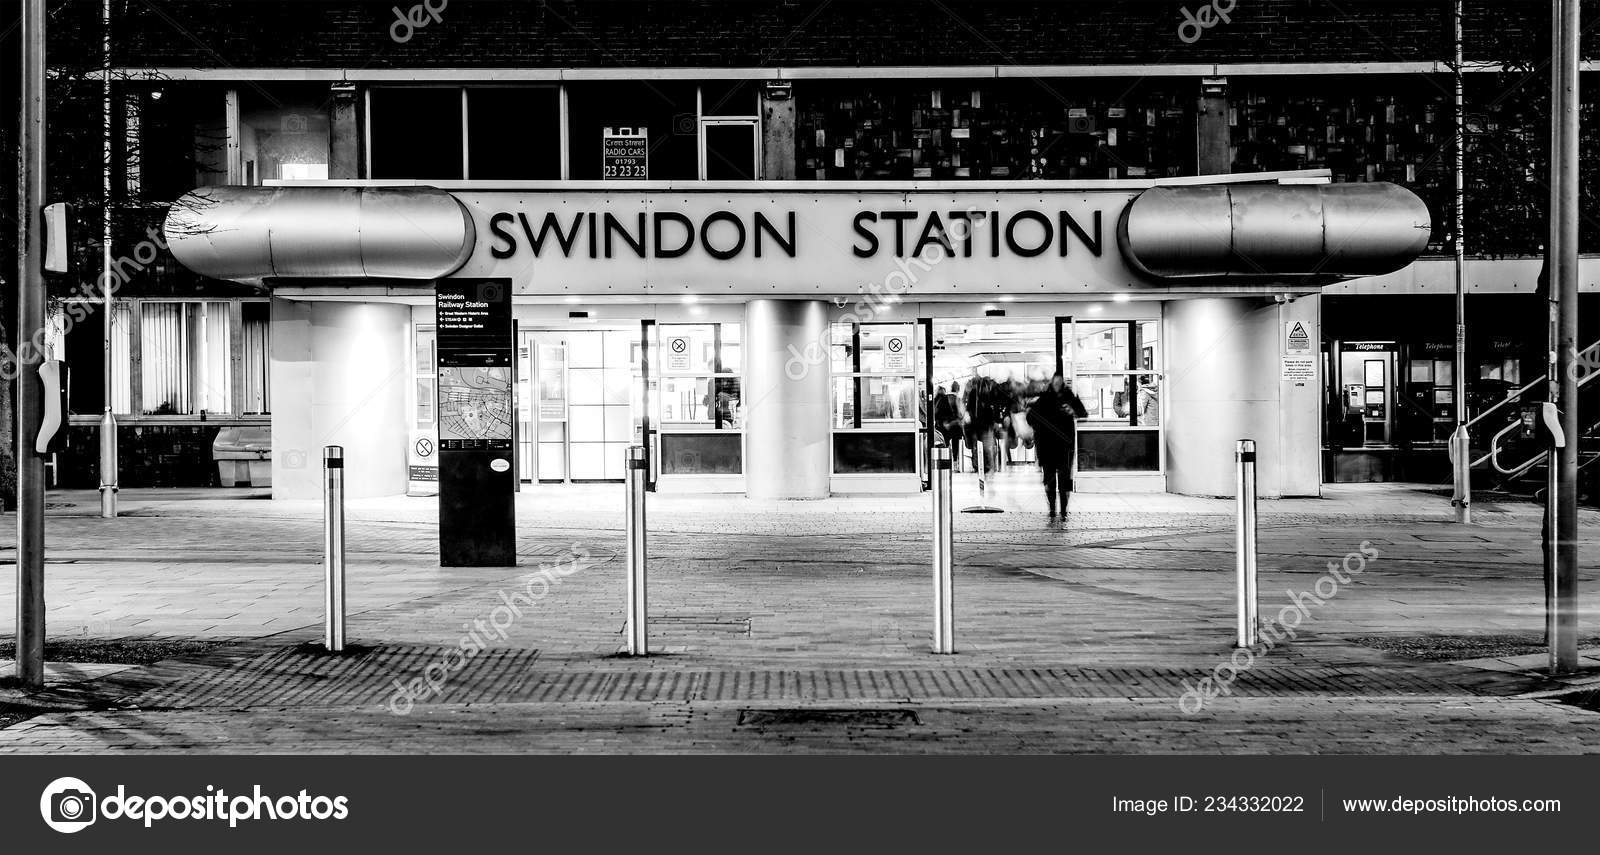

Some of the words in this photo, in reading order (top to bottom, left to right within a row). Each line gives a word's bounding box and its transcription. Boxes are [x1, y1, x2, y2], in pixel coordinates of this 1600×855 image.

[605, 166, 617, 176] 23
[620, 166, 632, 176] 23
[634, 166, 646, 176] 23
[490, 211, 796, 260] SWINDON
[853, 210, 1103, 258] STATION
[438, 301, 464, 310] Railway
[1355, 343, 1384, 351] Telephone
